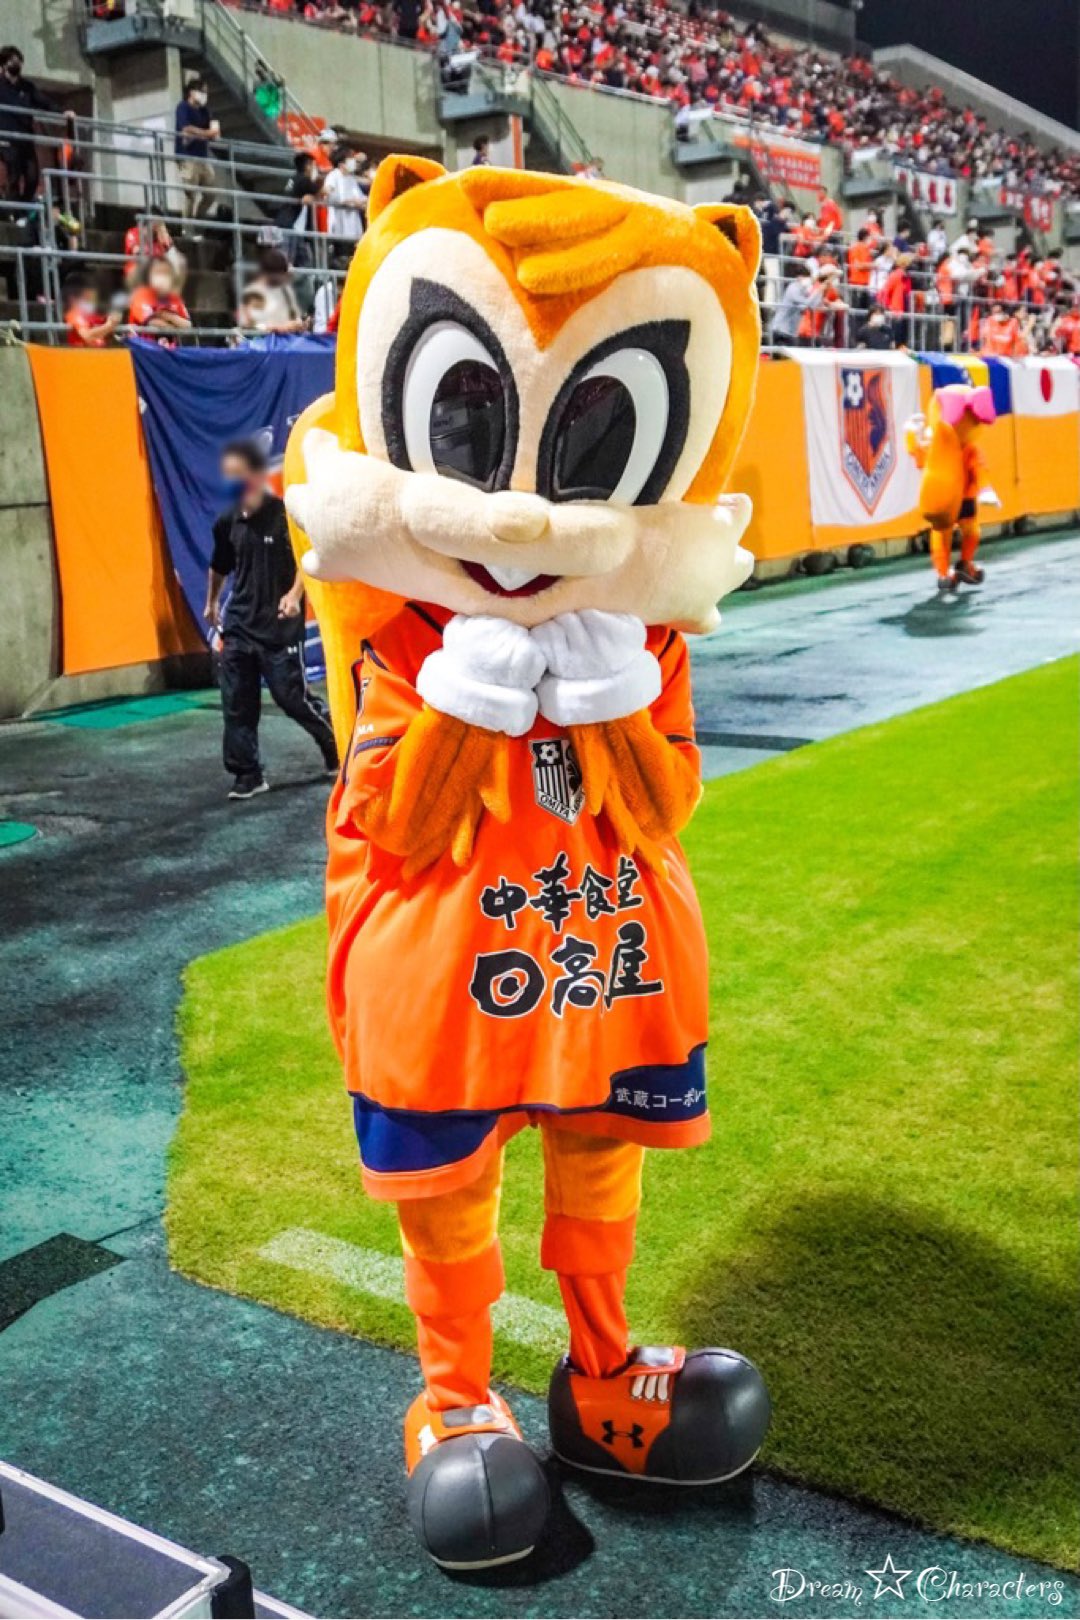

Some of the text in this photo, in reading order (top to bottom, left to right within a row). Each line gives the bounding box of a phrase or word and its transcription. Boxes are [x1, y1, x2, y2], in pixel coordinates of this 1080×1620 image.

[479, 851, 643, 934] 中華食堂
[468, 920, 664, 1018] 日高屋
